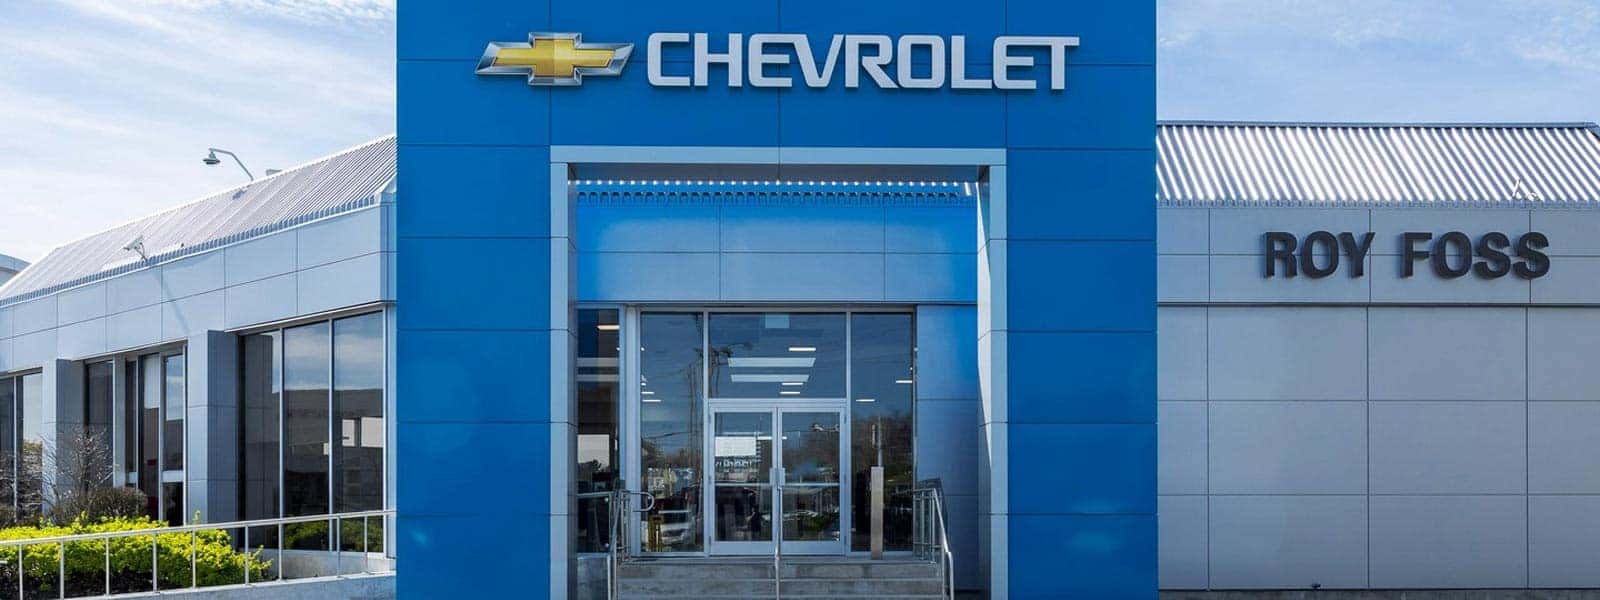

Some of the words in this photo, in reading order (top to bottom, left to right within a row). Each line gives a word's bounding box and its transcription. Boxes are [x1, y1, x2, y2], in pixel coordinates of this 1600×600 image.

[647, 32, 1080, 90] CHEVROLET
[1264, 231, 1376, 279] ROY
[1401, 231, 1550, 279] FOSS
